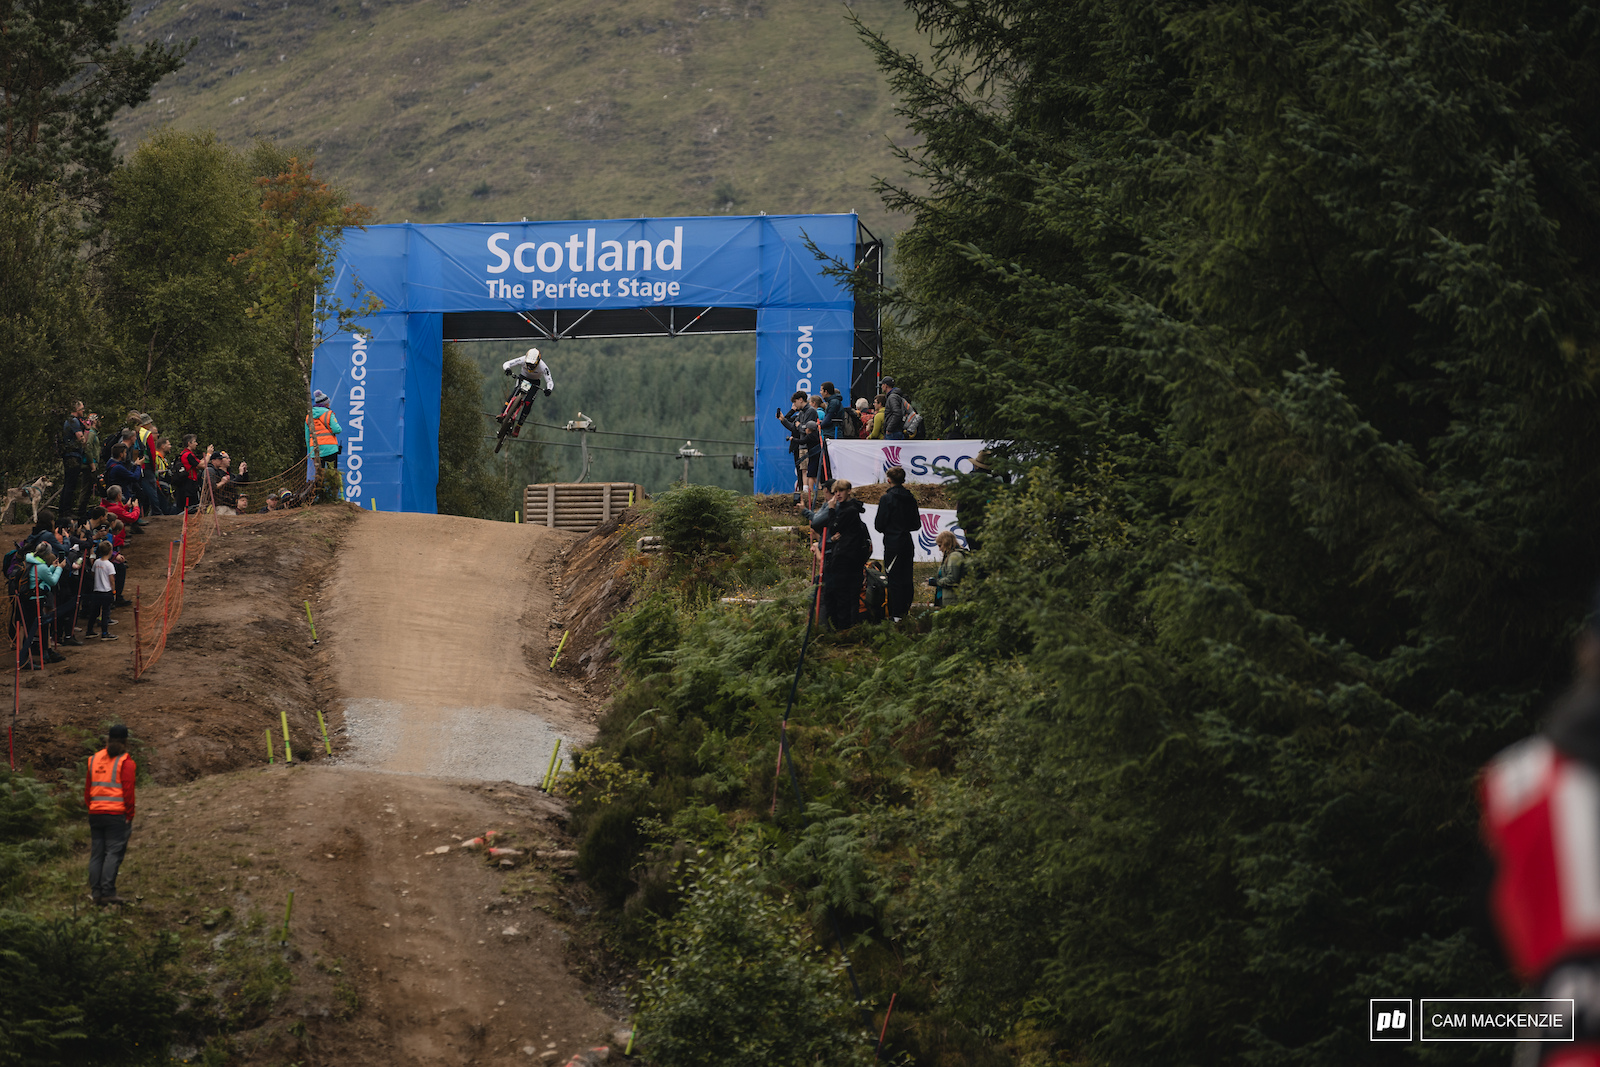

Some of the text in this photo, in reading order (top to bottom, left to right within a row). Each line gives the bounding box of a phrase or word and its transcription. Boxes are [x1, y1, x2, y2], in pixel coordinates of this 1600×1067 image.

[486, 226, 683, 274] Scotland
[485, 277, 681, 302] The Perfect Stage
